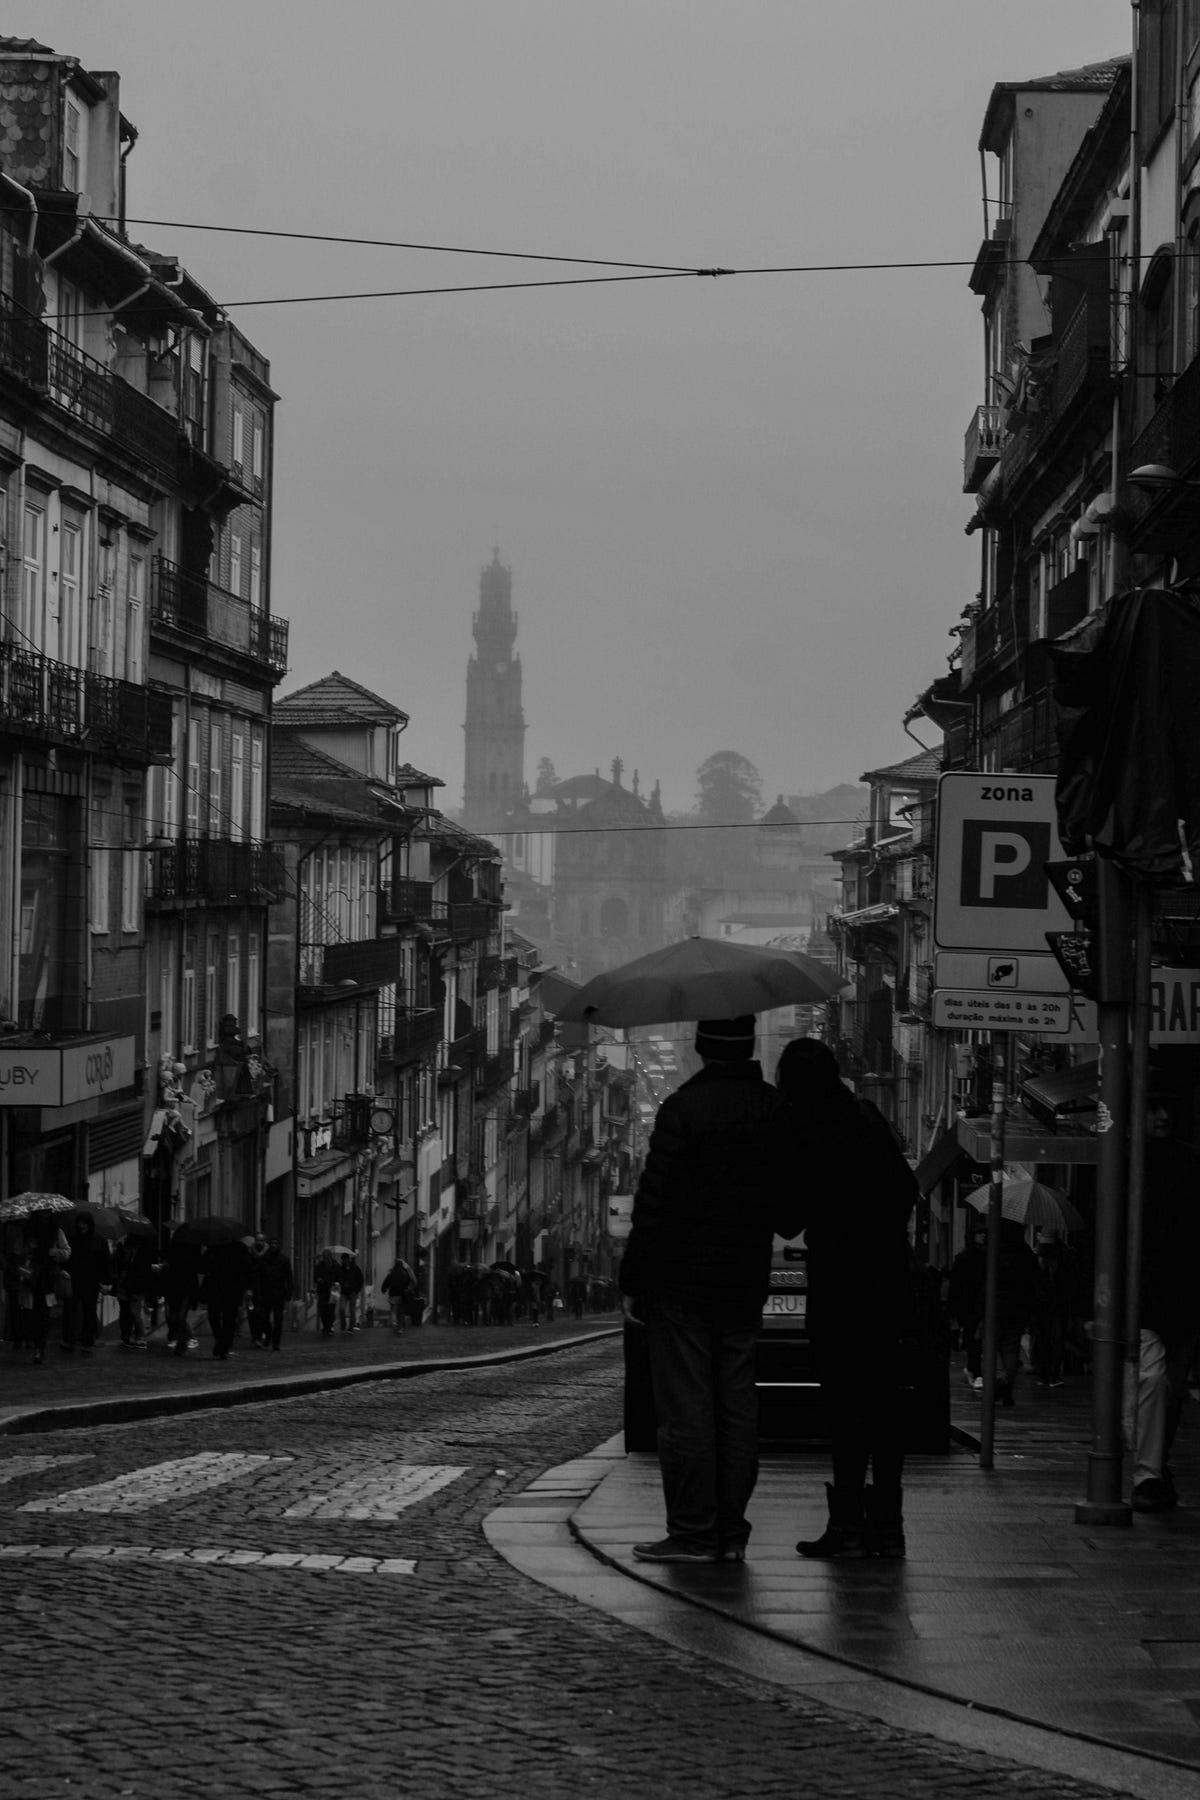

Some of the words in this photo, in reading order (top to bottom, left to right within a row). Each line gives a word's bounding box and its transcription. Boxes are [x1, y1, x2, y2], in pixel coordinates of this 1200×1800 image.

[981, 786, 1033, 801] zona
[979, 831, 1031, 898] P
[944, 998, 963, 1007] dias
[967, 999, 990, 1008] úteis
[994, 1000, 1010, 1009] das
[1015, 1002, 1022, 1010] 8
[1027, 1001, 1037, 1011] às
[1042, 1003, 1061, 1012] 20h
[947, 1012, 984, 1022] duração
[988, 1013, 1023, 1023] máxima
[1028, 1015, 1039, 1024] de
[1044, 1016, 1056, 1025] 2h
